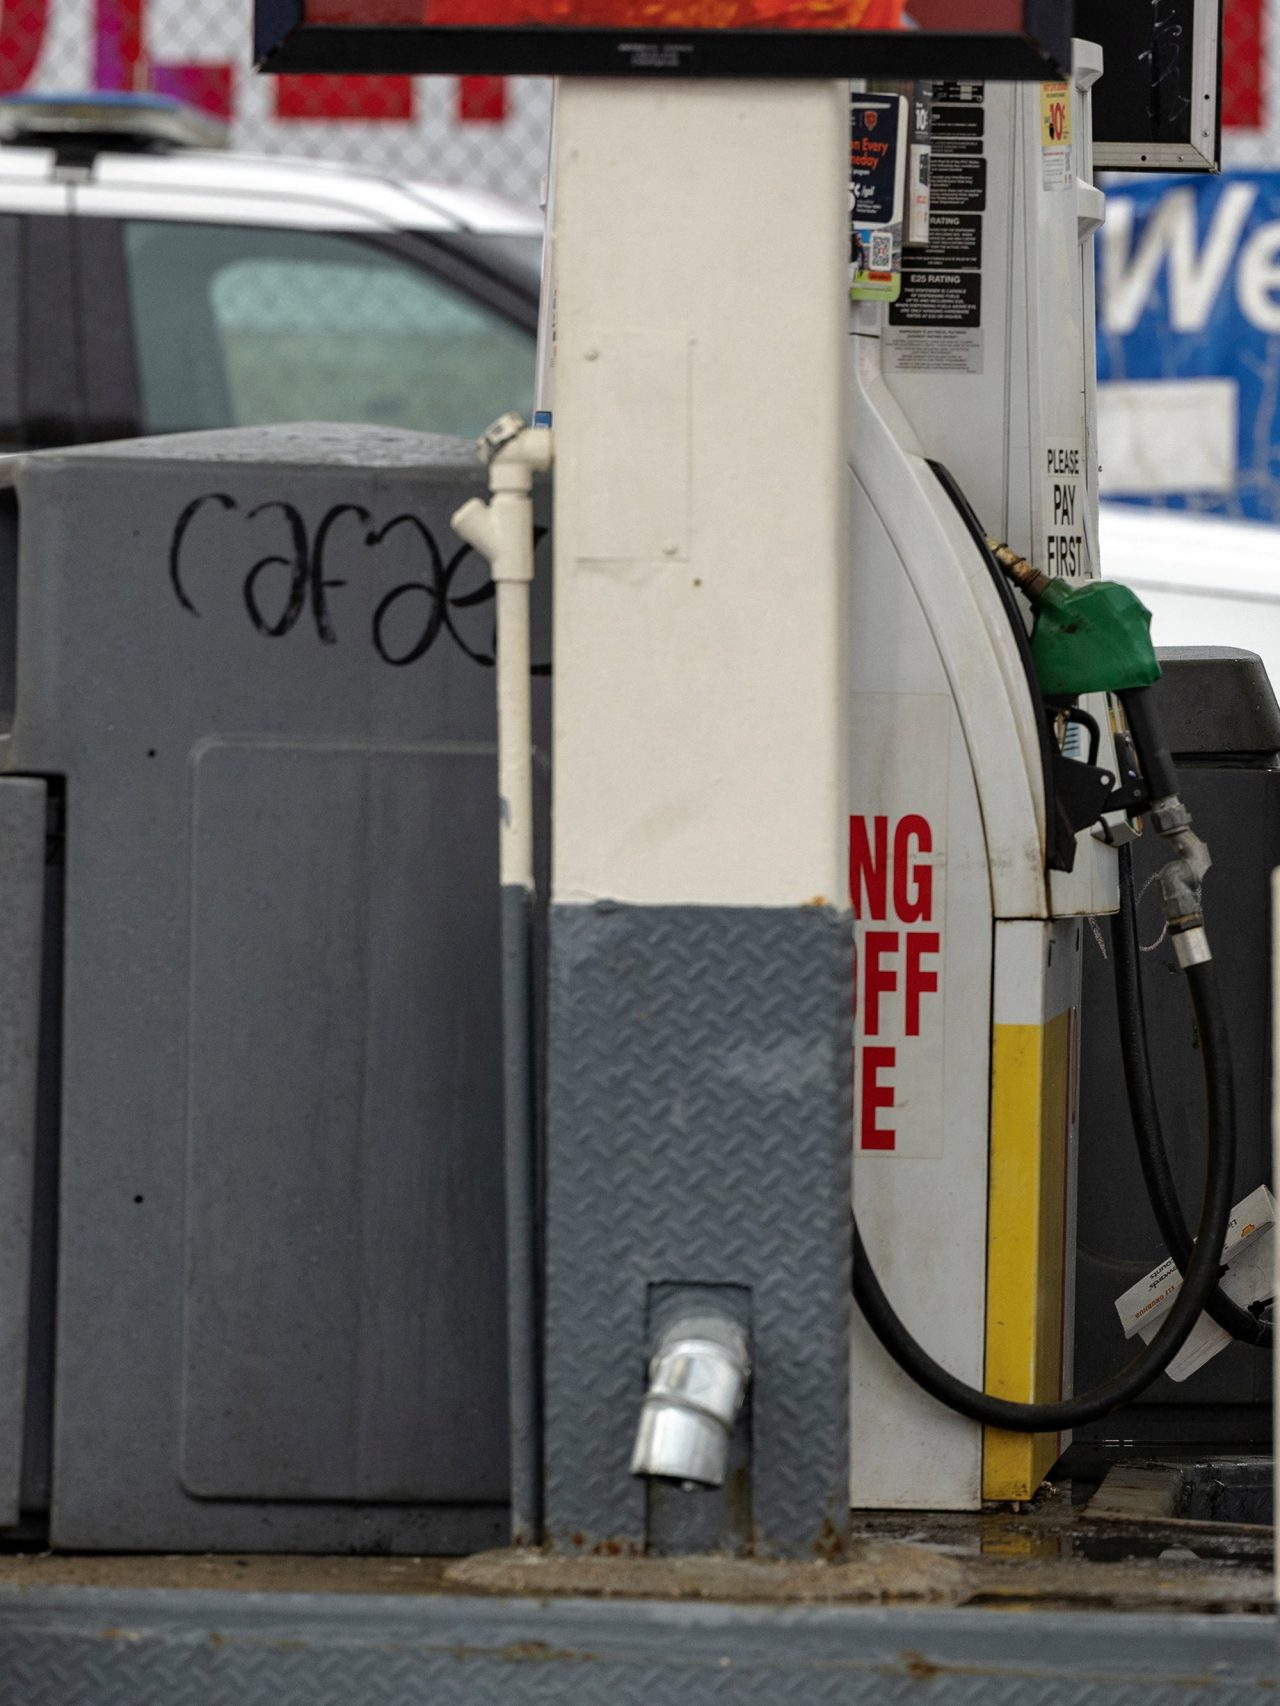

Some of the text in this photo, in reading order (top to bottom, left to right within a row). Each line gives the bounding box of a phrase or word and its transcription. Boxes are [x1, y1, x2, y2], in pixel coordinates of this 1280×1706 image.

[862, 137, 889, 157] Every
[910, 274, 961, 284] E25 RATING
[1047, 448, 1080, 474] PLEASE
[1053, 484, 1076, 526] PAY
[1047, 535, 1082, 577] FIRST
[849, 814, 932, 923] NG
[852, 931, 940, 1036] FF
